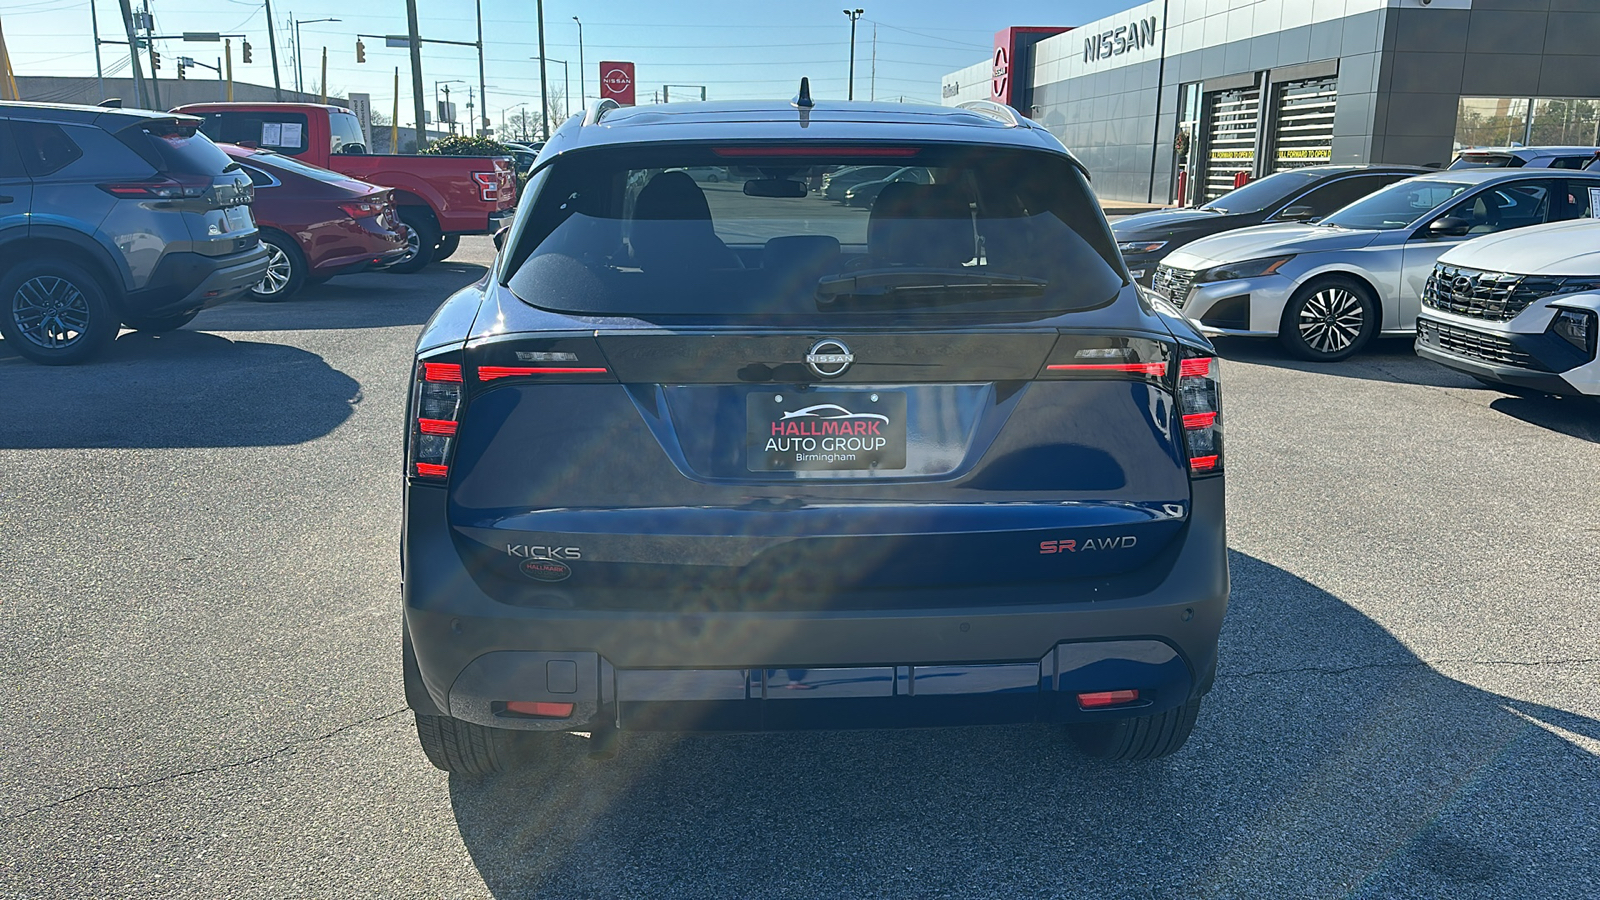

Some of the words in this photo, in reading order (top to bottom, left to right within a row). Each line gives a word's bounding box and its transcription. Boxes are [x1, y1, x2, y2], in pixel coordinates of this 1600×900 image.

[1083, 16, 1157, 64] NISSAN
[772, 421, 880, 436] HALLMARK
[765, 438, 816, 451] AUTO
[822, 437, 886, 451] GROUP
[796, 453, 856, 463] Birmingham
[507, 544, 581, 559] KICKS
[1040, 539, 1076, 554] SR
[1081, 536, 1137, 551] AWD
[526, 564, 564, 572] HALLMARK
